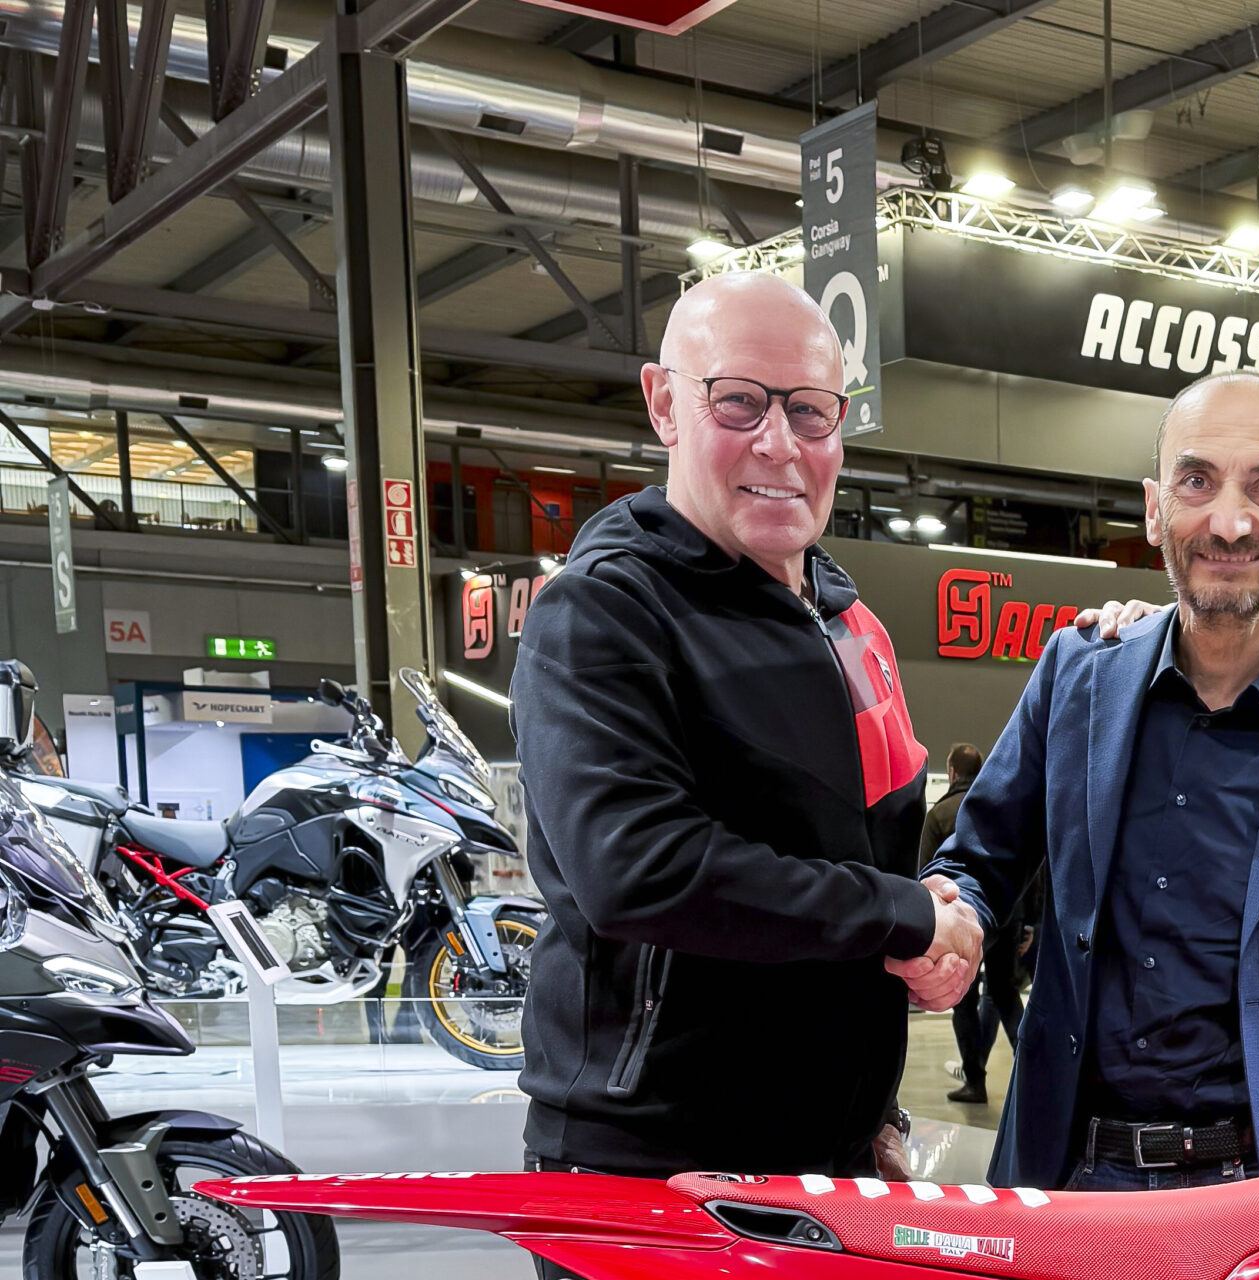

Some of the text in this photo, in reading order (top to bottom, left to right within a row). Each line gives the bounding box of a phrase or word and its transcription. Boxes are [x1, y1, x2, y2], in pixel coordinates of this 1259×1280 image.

[826, 148, 844, 204] 5
[811, 219, 839, 242] Corsia
[811, 233, 852, 259] Gangway
[820, 271, 868, 386] Q
[56, 550, 73, 609] S
[109, 621, 147, 643] 5A
[210, 703, 265, 713] HOPECHART
[895, 1226, 930, 1245] SELLE
[977, 1238, 1012, 1259] VALLE
[941, 1247, 964, 1255] ITALY
